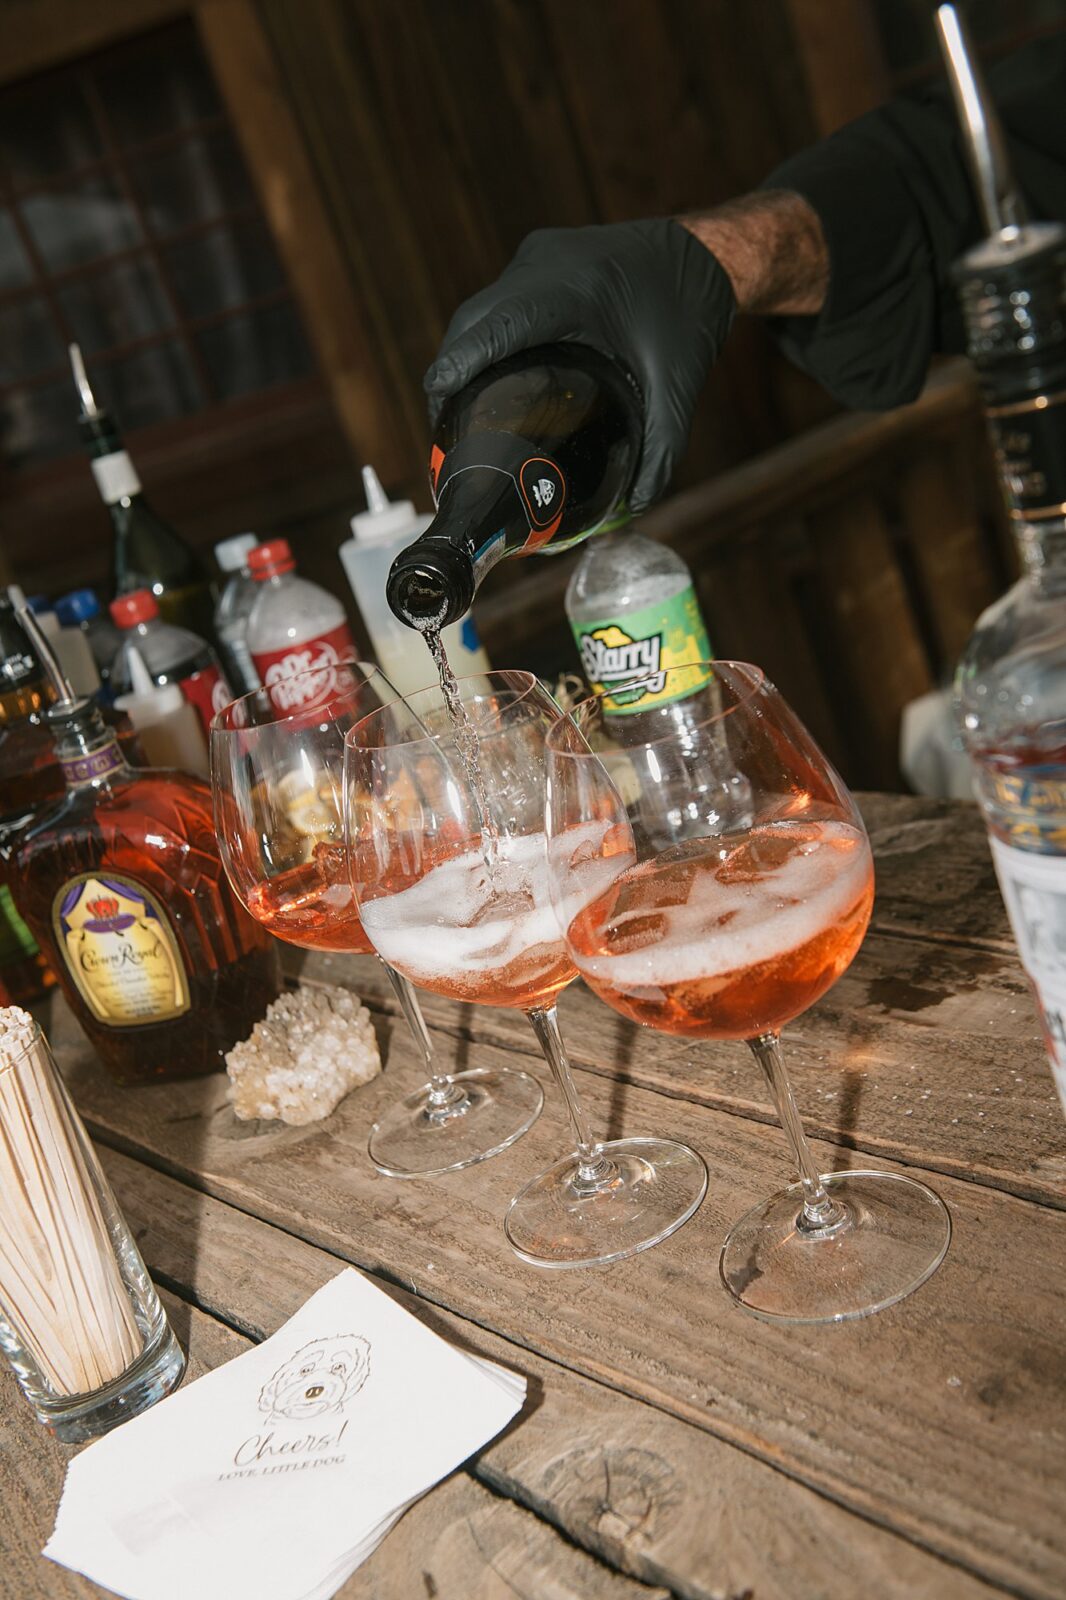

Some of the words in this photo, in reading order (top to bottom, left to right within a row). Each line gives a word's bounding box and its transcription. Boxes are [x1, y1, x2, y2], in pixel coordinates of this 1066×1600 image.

[580, 634, 667, 693] Starry
[81, 949, 119, 972] Crown
[115, 942, 162, 968] Royal
[234, 1420, 348, 1467] Cheers!
[262, 1461, 311, 1475] LITTLE
[312, 1455, 347, 1467] DOG
